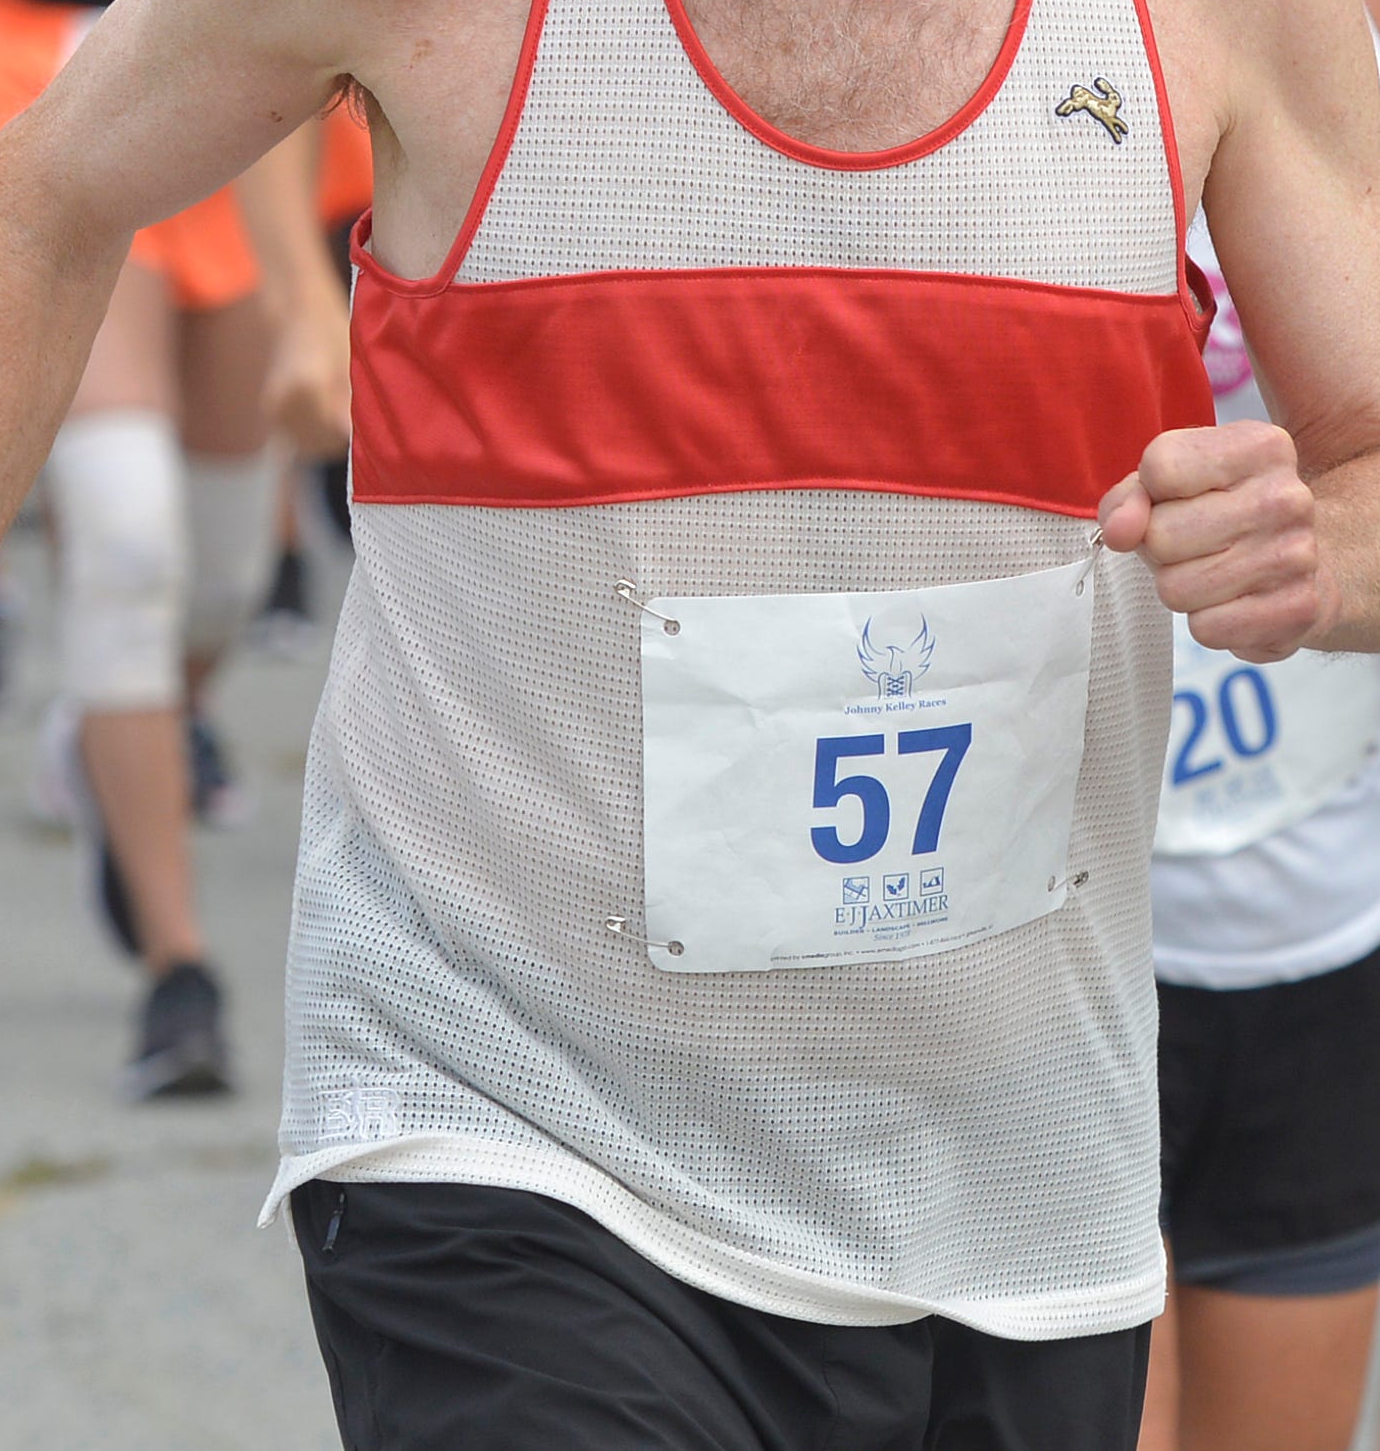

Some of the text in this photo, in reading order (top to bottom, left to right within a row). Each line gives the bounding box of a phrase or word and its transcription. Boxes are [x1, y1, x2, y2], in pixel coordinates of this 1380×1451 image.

[845, 698, 947, 715] Johnny Kelley Races
[1171, 665, 1280, 789] 20
[810, 722, 972, 864] 57
